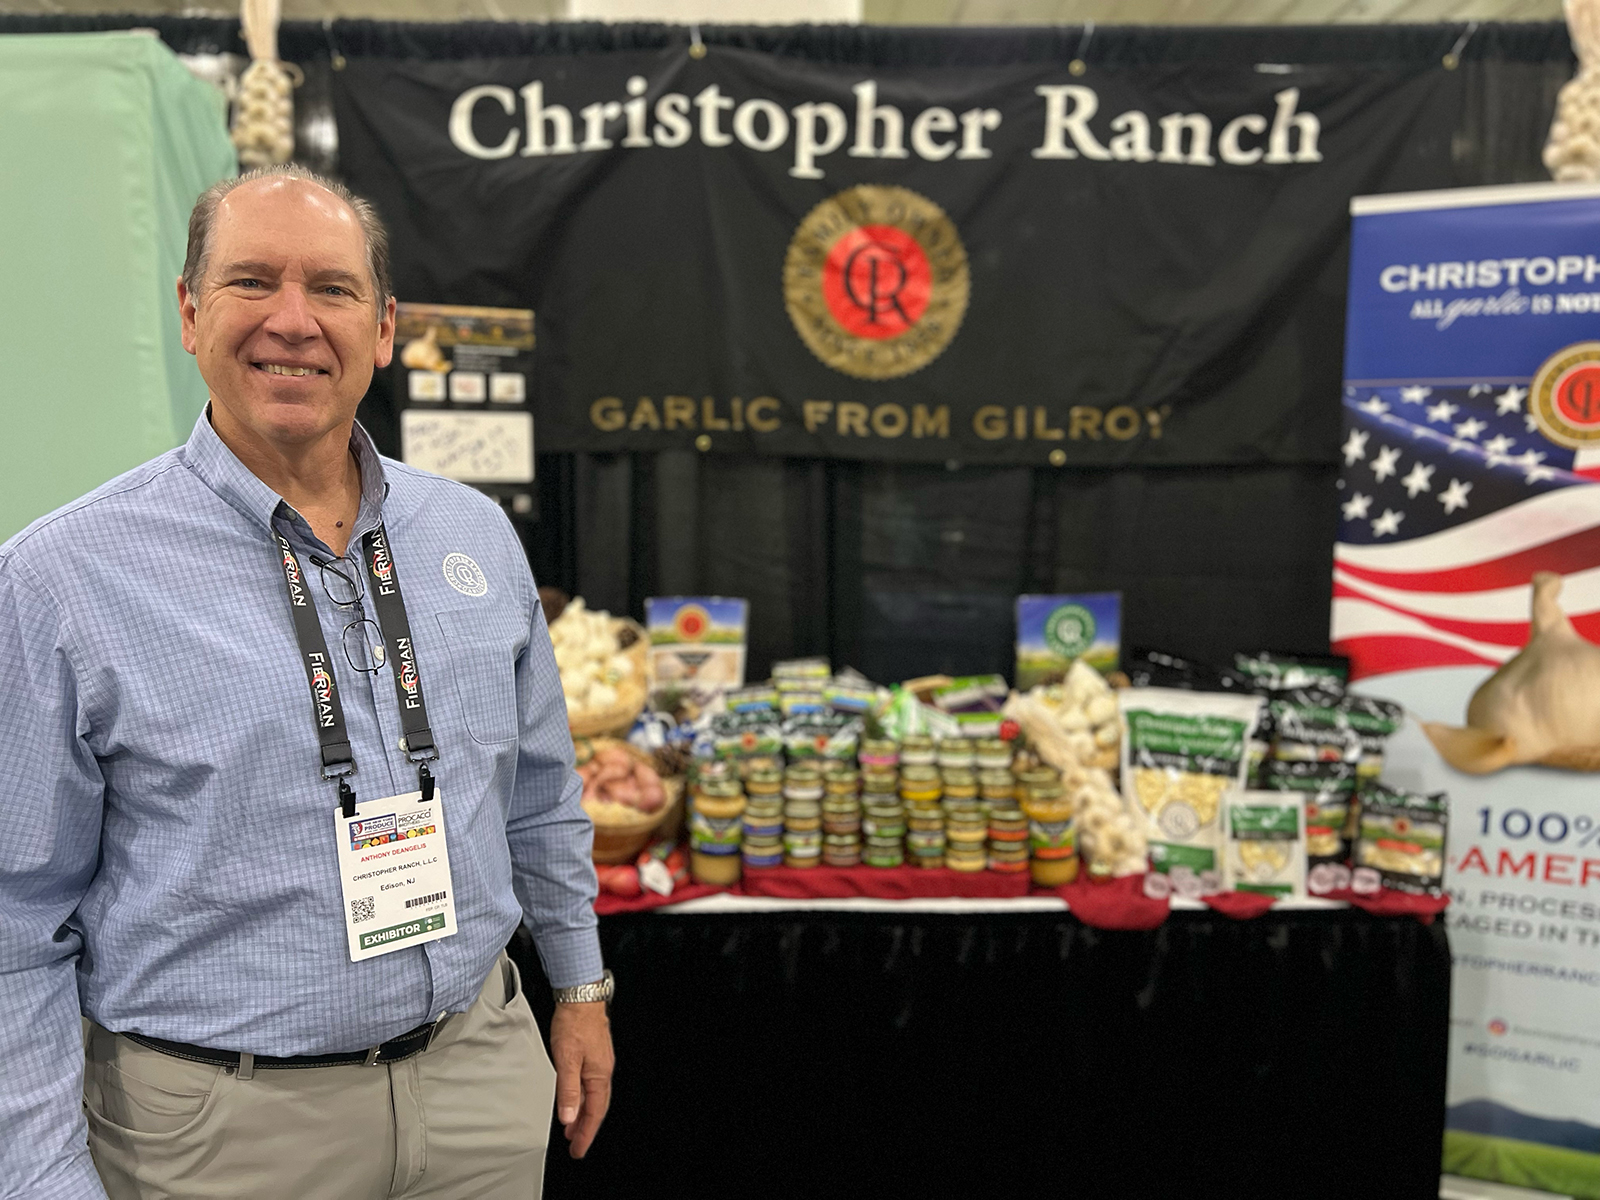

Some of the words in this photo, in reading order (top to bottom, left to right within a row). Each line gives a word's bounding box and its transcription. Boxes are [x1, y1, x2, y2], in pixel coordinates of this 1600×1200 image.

[449, 76, 1001, 178] Christopher
[1033, 85, 1321, 165] Ranch
[1380, 255, 1600, 293] CHRISTOPH
[1531, 295, 1553, 315] IS
[590, 396, 781, 433] GARLIC
[803, 401, 950, 439] FROM
[973, 404, 1166, 441] GILROY
[279, 536, 306, 607] FIERMAN
[371, 530, 395, 596] FIERMAN
[308, 652, 335, 728] FIERMAN
[397, 637, 421, 710] FIERMAN
[1478, 806, 1600, 848] 100%
[361, 851, 390, 862] ANTHONY
[392, 843, 427, 856] DEANGELIS
[353, 866, 397, 881] CHRISTOPHER
[380, 881, 405, 891] Edison,
[1479, 890, 1600, 922] PROCES
[364, 923, 421, 946] EXHIBITOR
[1448, 912, 1534, 940] AGED
[1539, 922, 1569, 943] IN
